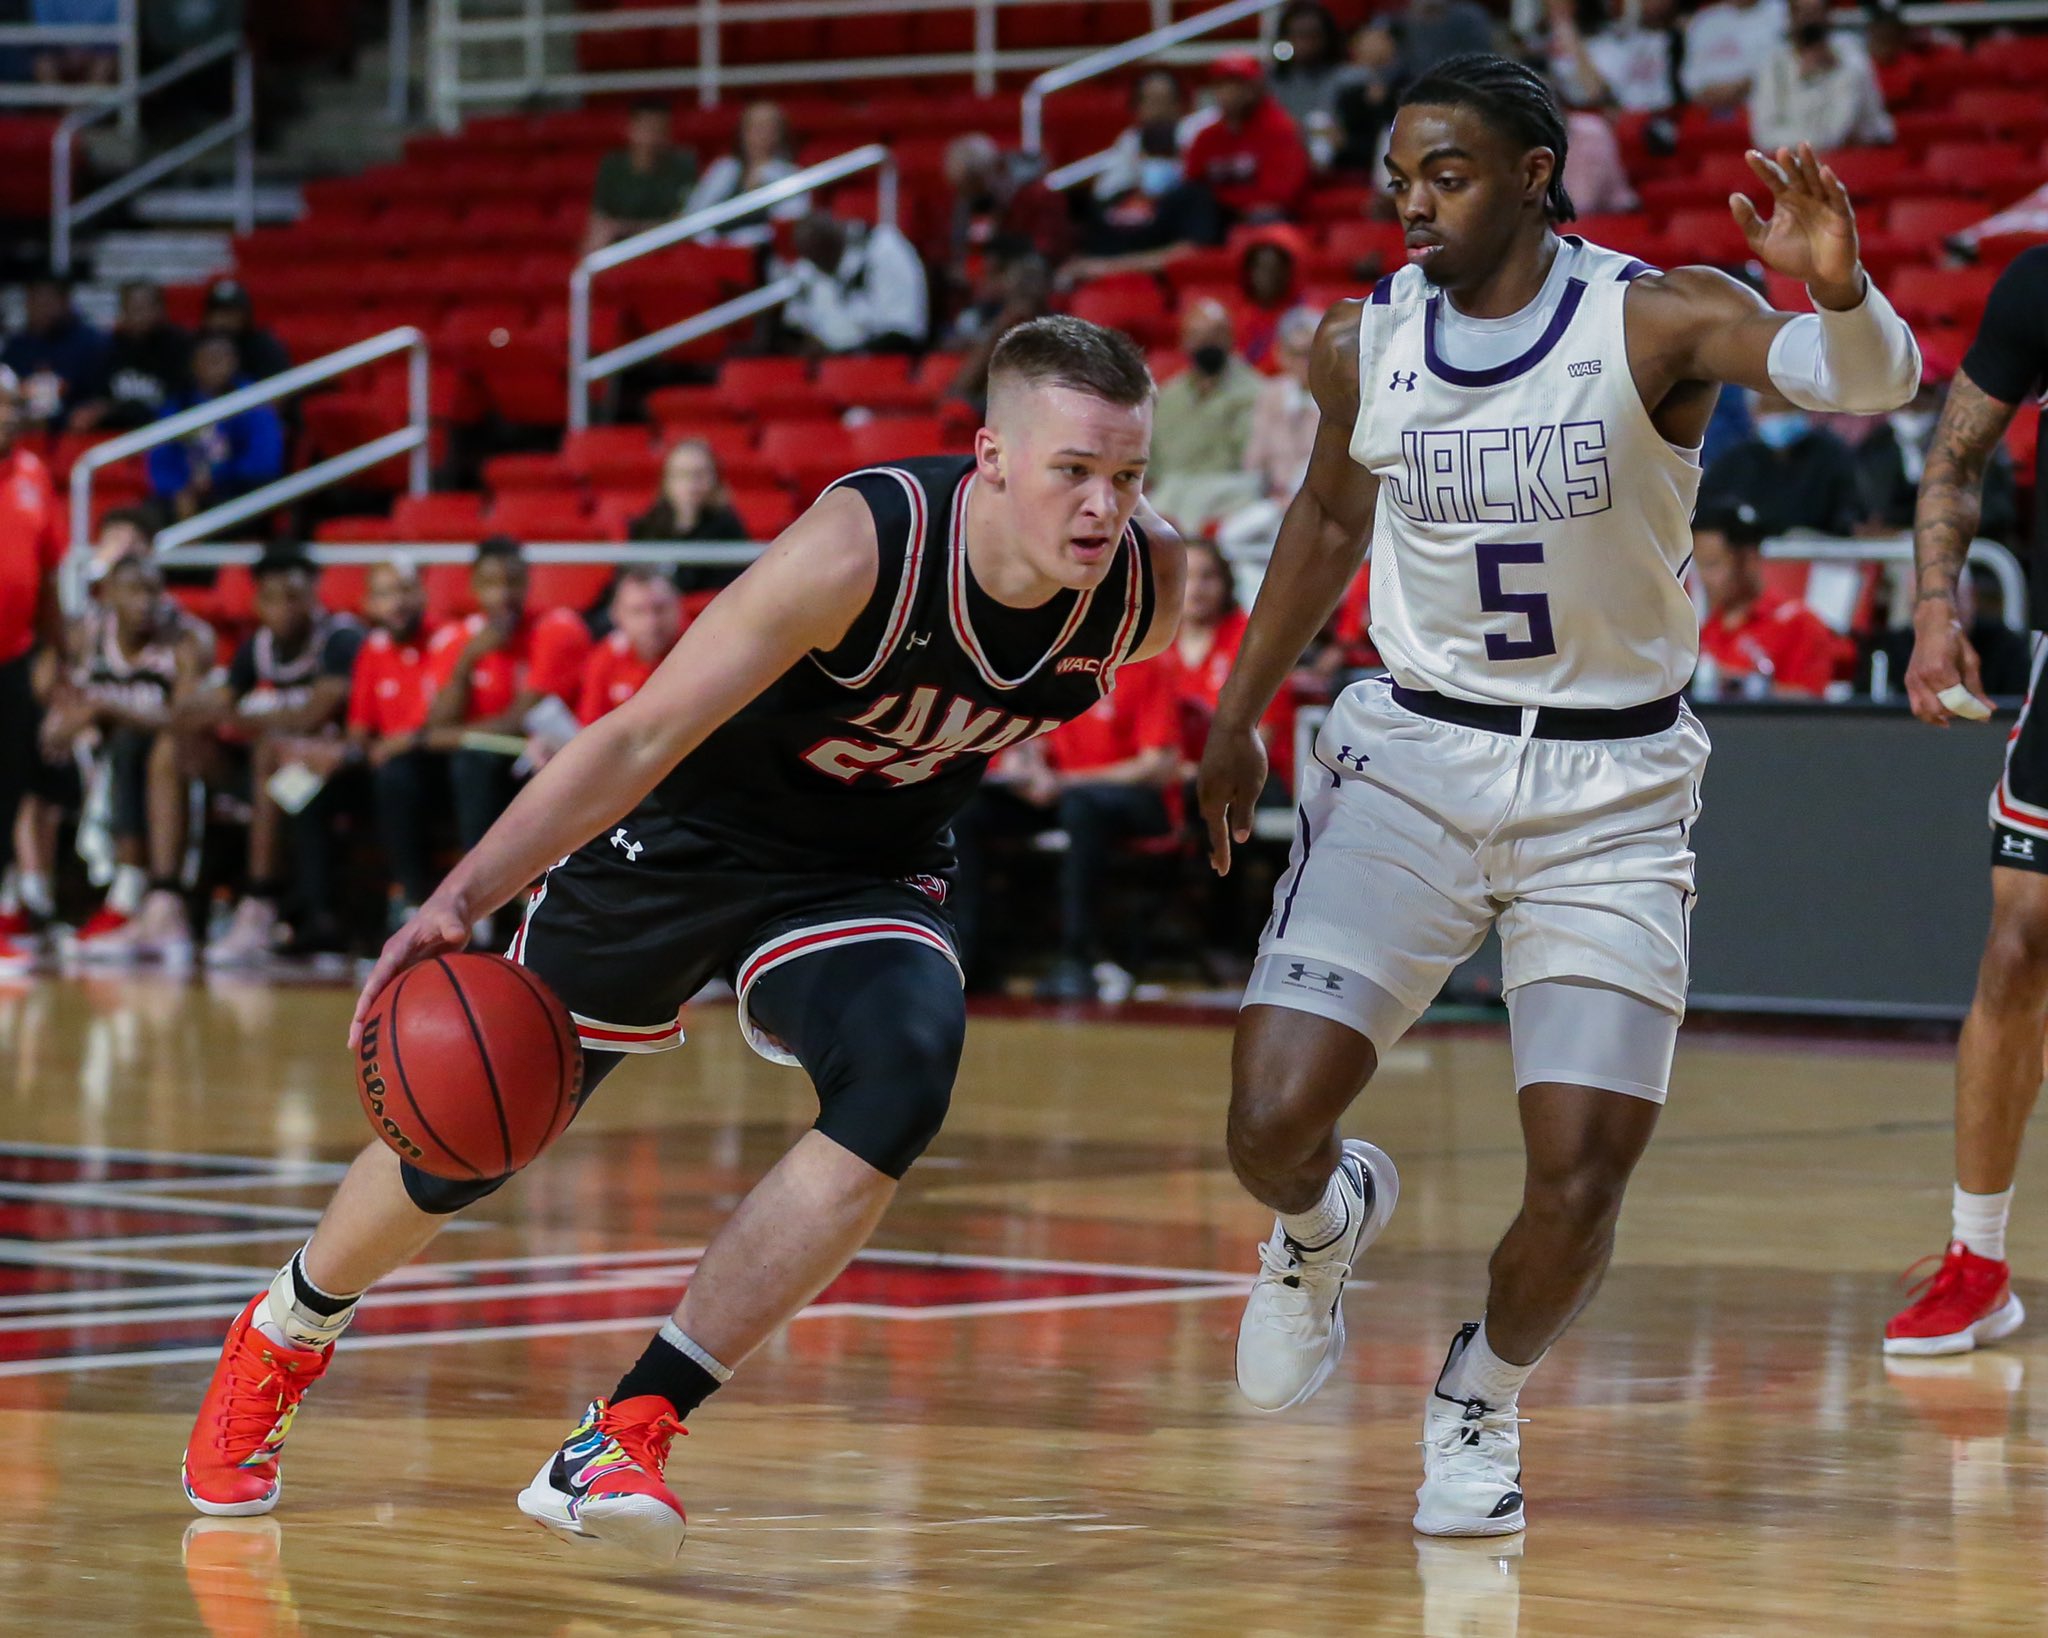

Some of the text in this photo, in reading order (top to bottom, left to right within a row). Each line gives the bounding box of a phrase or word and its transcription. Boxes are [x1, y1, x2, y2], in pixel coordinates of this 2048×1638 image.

[1567, 359, 1602, 378] WAC
[1388, 420, 1612, 523] JACKS
[1475, 542, 1556, 661] 5
[1055, 656, 1100, 675] WAC
[361, 1012, 423, 1159] Wilson
